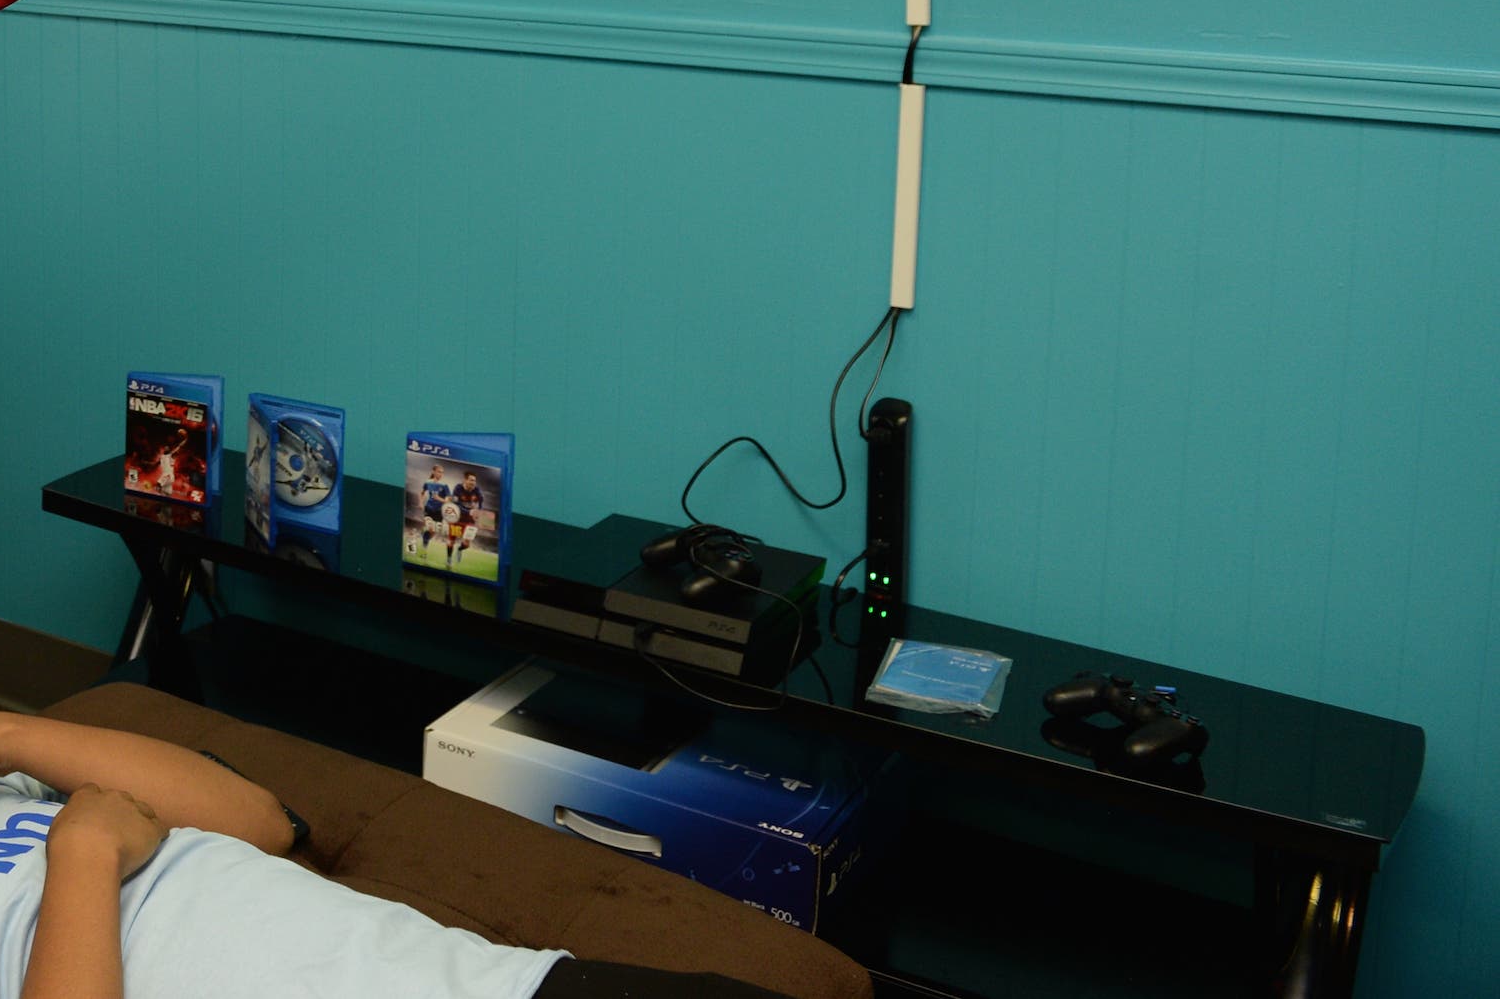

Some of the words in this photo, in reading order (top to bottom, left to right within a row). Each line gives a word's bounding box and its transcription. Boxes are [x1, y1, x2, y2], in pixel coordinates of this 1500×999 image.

[141, 383, 164, 394] PS4
[422, 444, 450, 456] PS4
[438, 740, 475, 758] SONY
[700, 755, 771, 780] PS4
[758, 822, 805, 839] SONY
